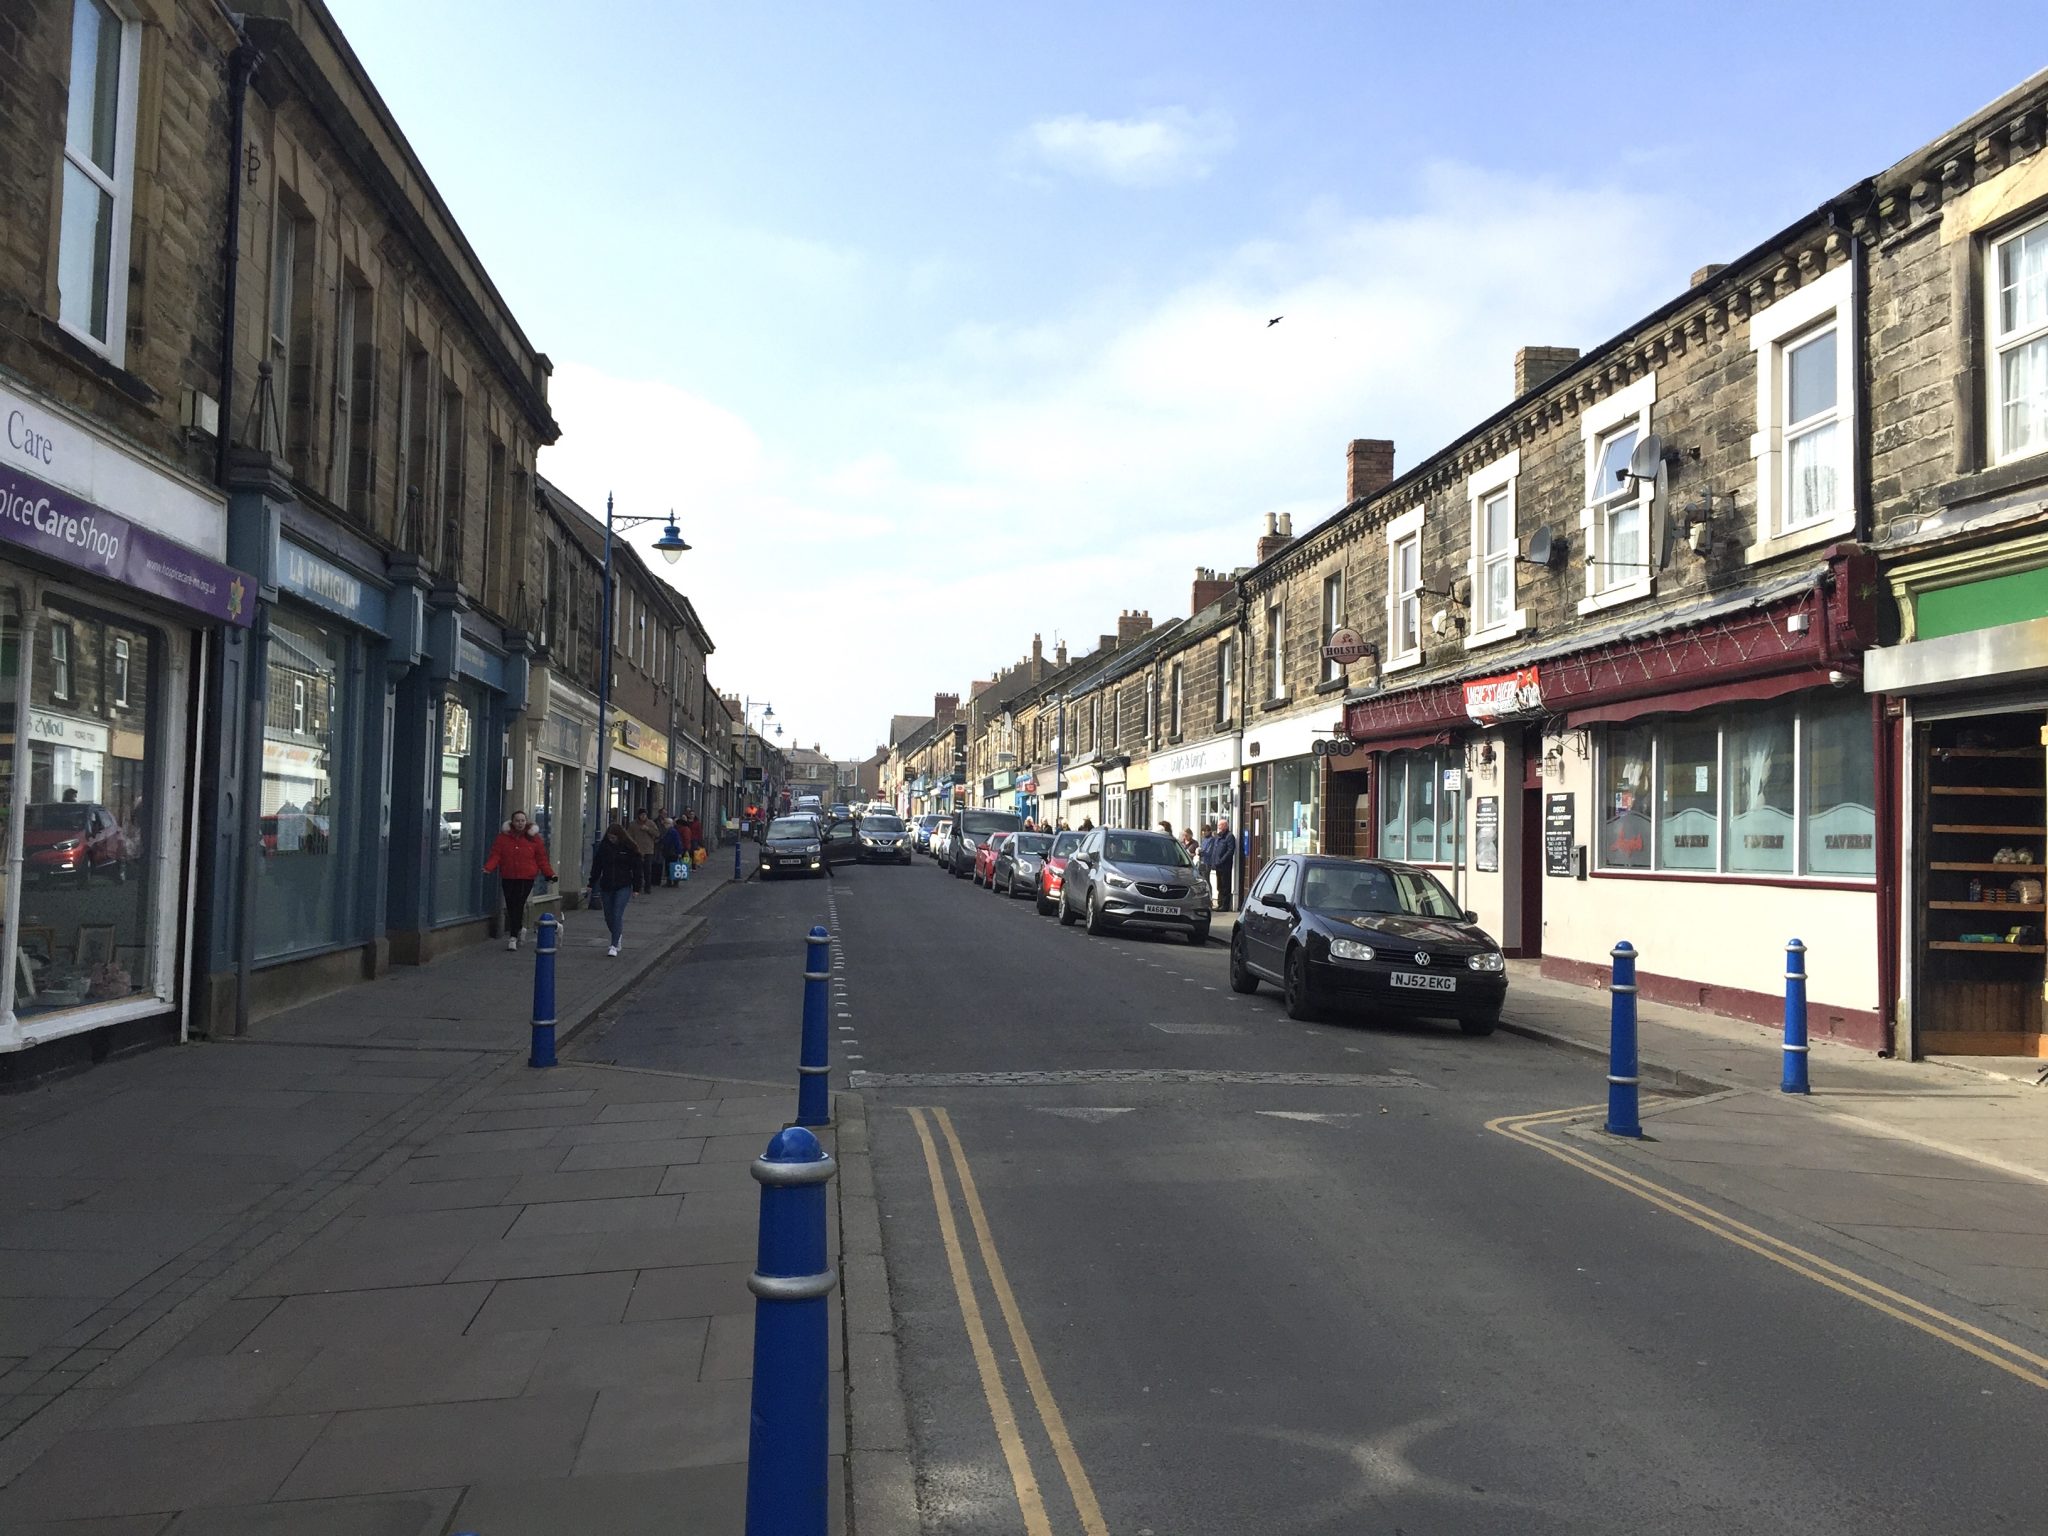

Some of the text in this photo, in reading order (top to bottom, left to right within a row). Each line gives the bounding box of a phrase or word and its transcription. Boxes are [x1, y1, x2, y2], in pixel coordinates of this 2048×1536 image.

[8, 410, 53, 465] Care
[289, 550, 304, 585] LA
[1326, 644, 1370, 657] HOLSTEN
[1674, 834, 1709, 848] TAVERN
[1744, 834, 1785, 849] TAVERN
[1824, 834, 1873, 849] TAVERN
[1395, 973, 1451, 990] NJ52 EKG
